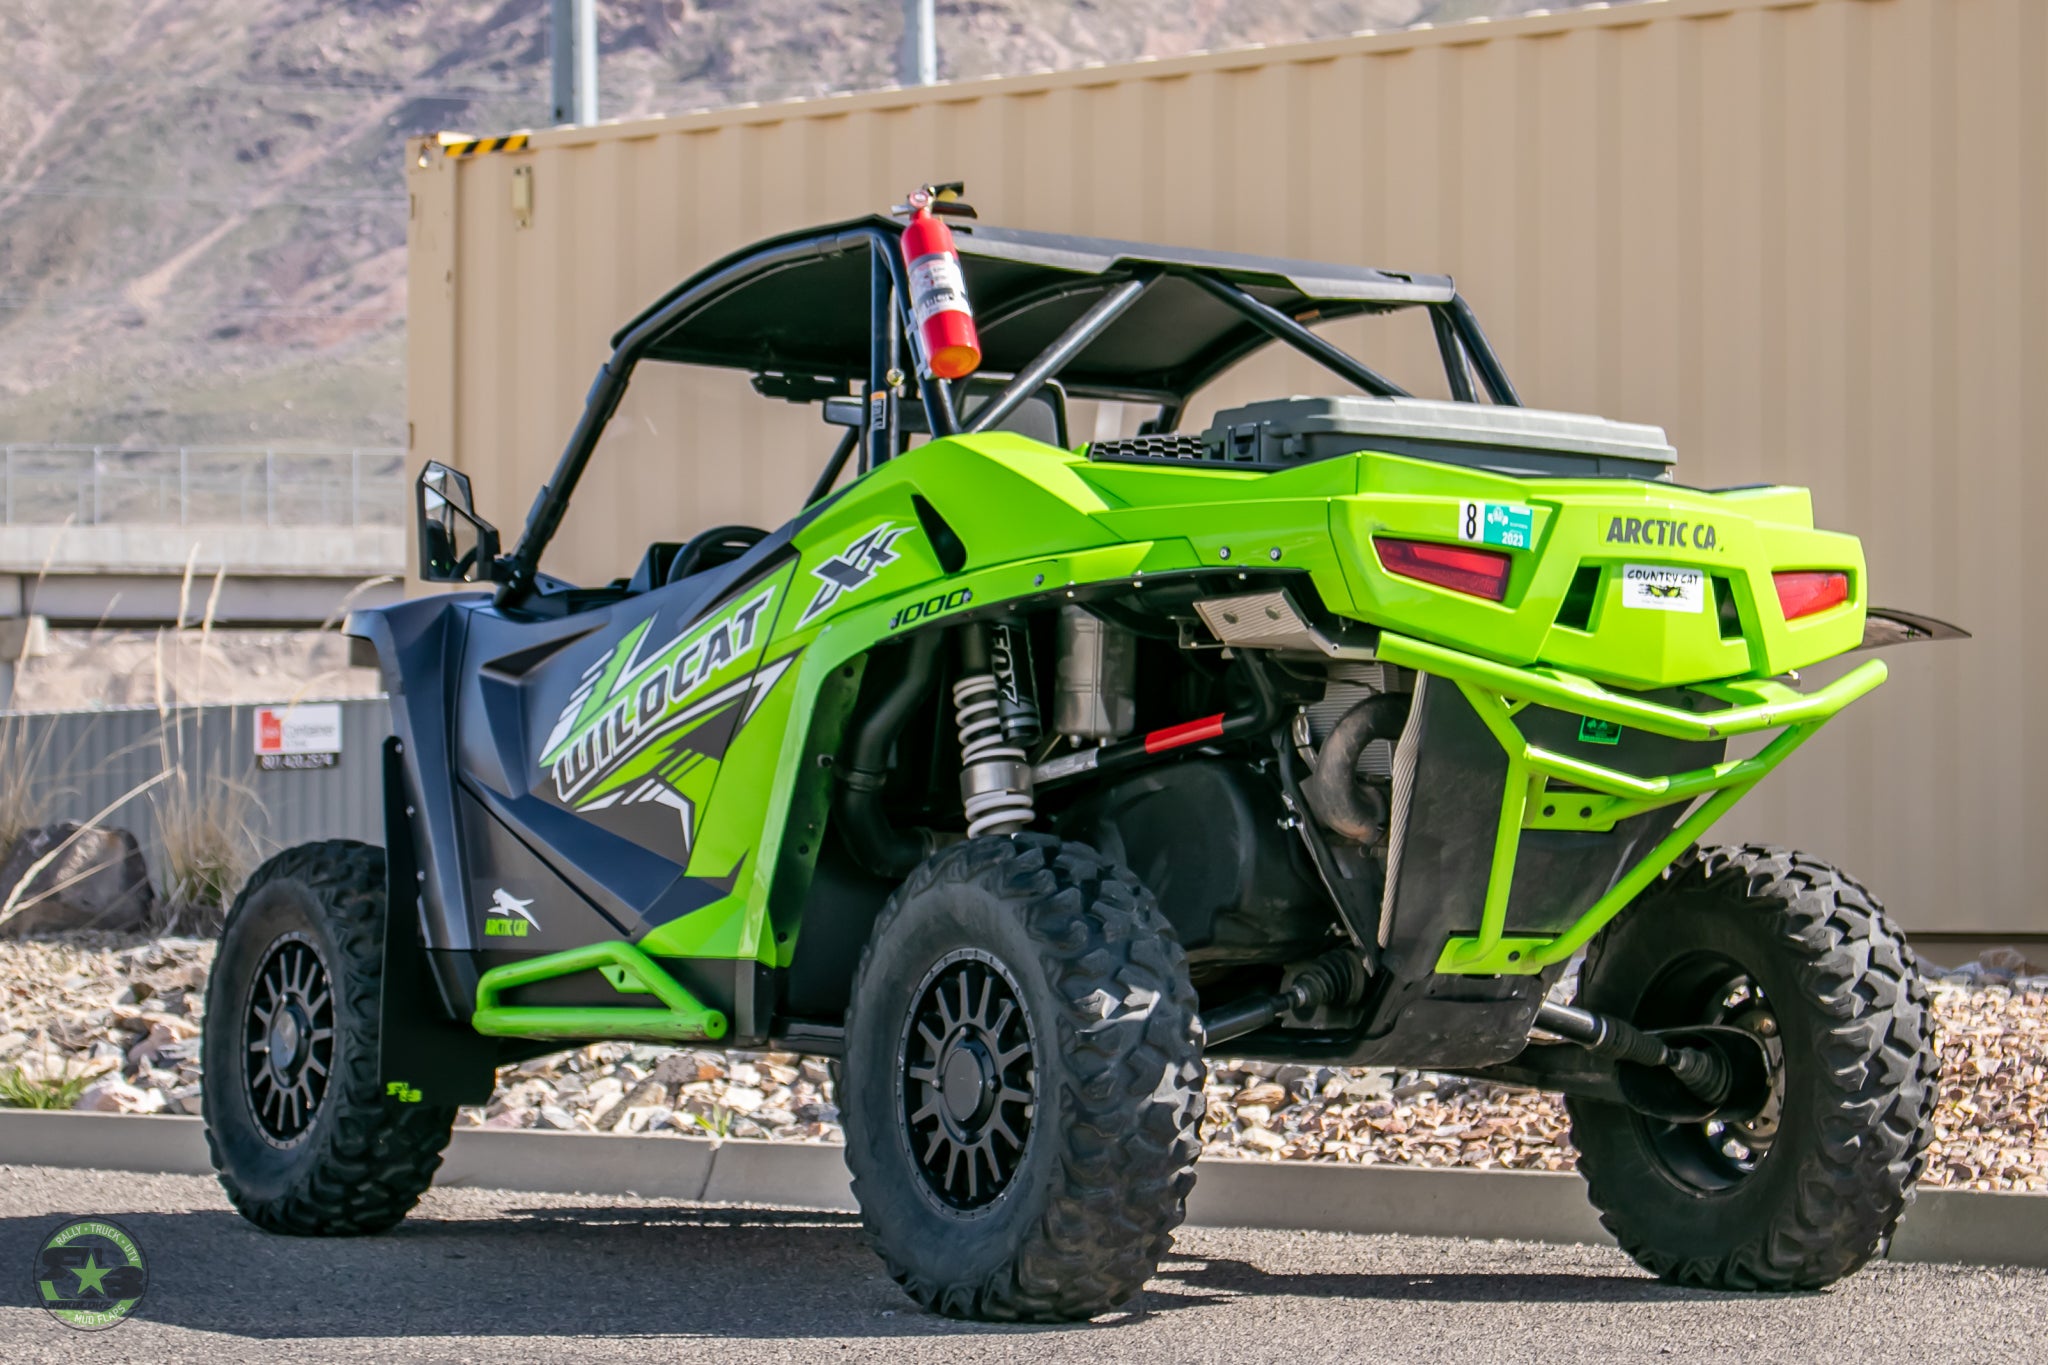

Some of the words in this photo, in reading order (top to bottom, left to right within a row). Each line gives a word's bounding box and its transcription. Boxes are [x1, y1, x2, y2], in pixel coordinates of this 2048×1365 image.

[1465, 503, 1478, 540] 8
[1501, 530, 1524, 548] 2023
[1605, 516, 1689, 549] ARCTIC
[1692, 523, 1718, 551] CA
[1626, 567, 1679, 587] COUNTRY
[1680, 573, 1699, 585] CAT
[889, 587, 973, 631] 1000
[552, 585, 777, 803] WILDCAT
[484, 917, 513, 937] ARCTIC
[513, 918, 530, 938] CAT
